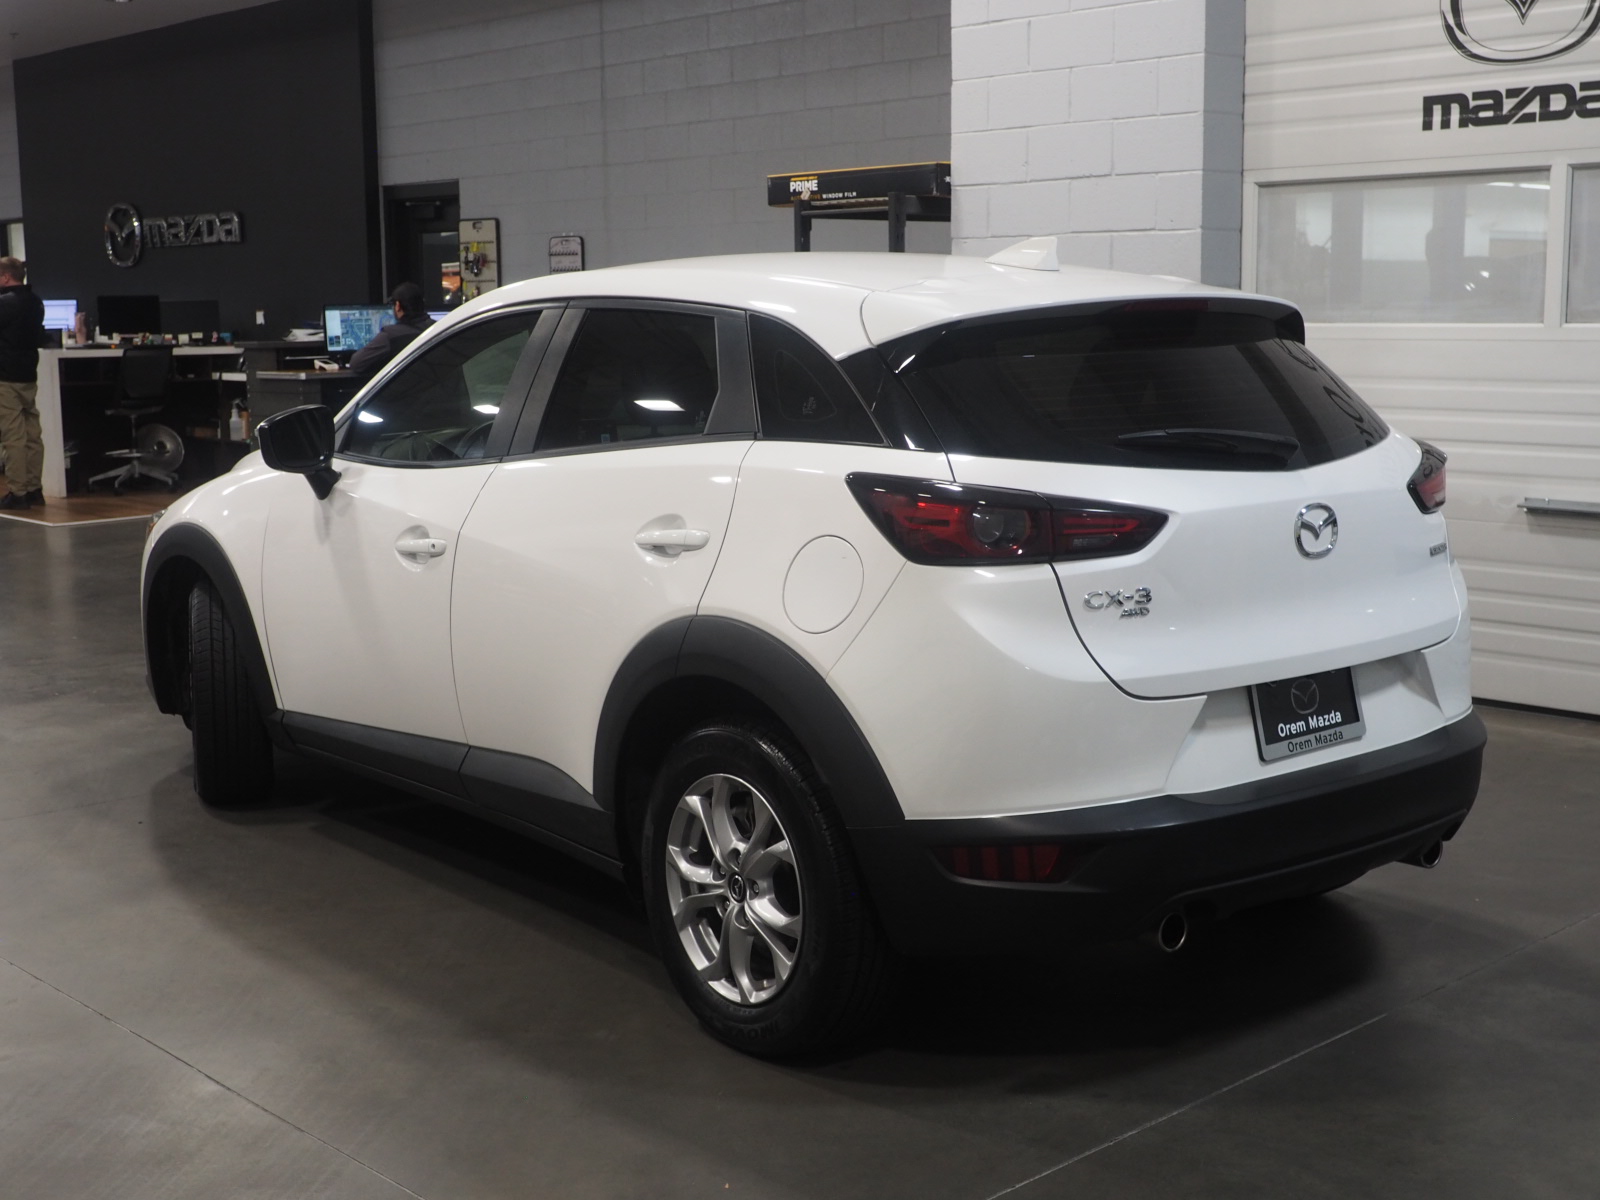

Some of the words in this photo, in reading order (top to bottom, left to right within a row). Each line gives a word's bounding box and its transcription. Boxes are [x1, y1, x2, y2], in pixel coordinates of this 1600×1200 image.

[789, 180, 819, 193] PRIME
[1083, 586, 1153, 610] CX-3
[1120, 606, 1150, 619] AWD
[1277, 720, 1307, 737] Orem
[1308, 709, 1342, 729] Mazda
[1287, 740, 1313, 753] Orem
[1314, 730, 1344, 746] Mazda
